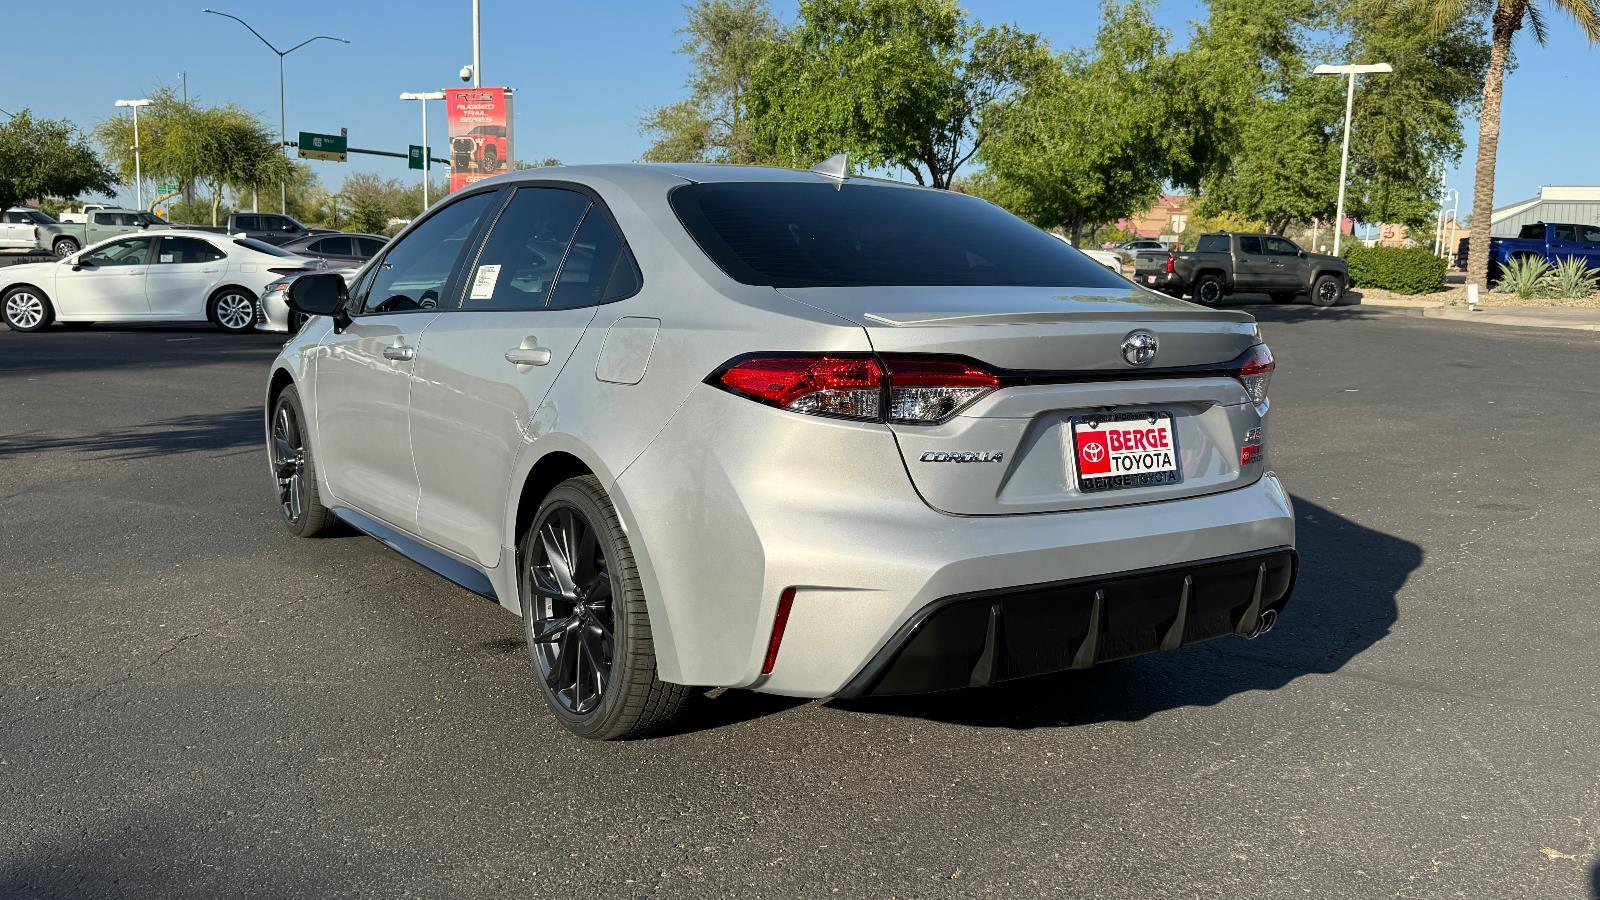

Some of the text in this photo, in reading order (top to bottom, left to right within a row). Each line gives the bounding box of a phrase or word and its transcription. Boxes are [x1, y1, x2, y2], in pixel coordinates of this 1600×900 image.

[1109, 428, 1169, 452] BERGE
[919, 451, 1004, 463] COROLLA
[1112, 453, 1172, 471] TOYOTA
[1082, 471, 1176, 489] BERGE TOYOTA
